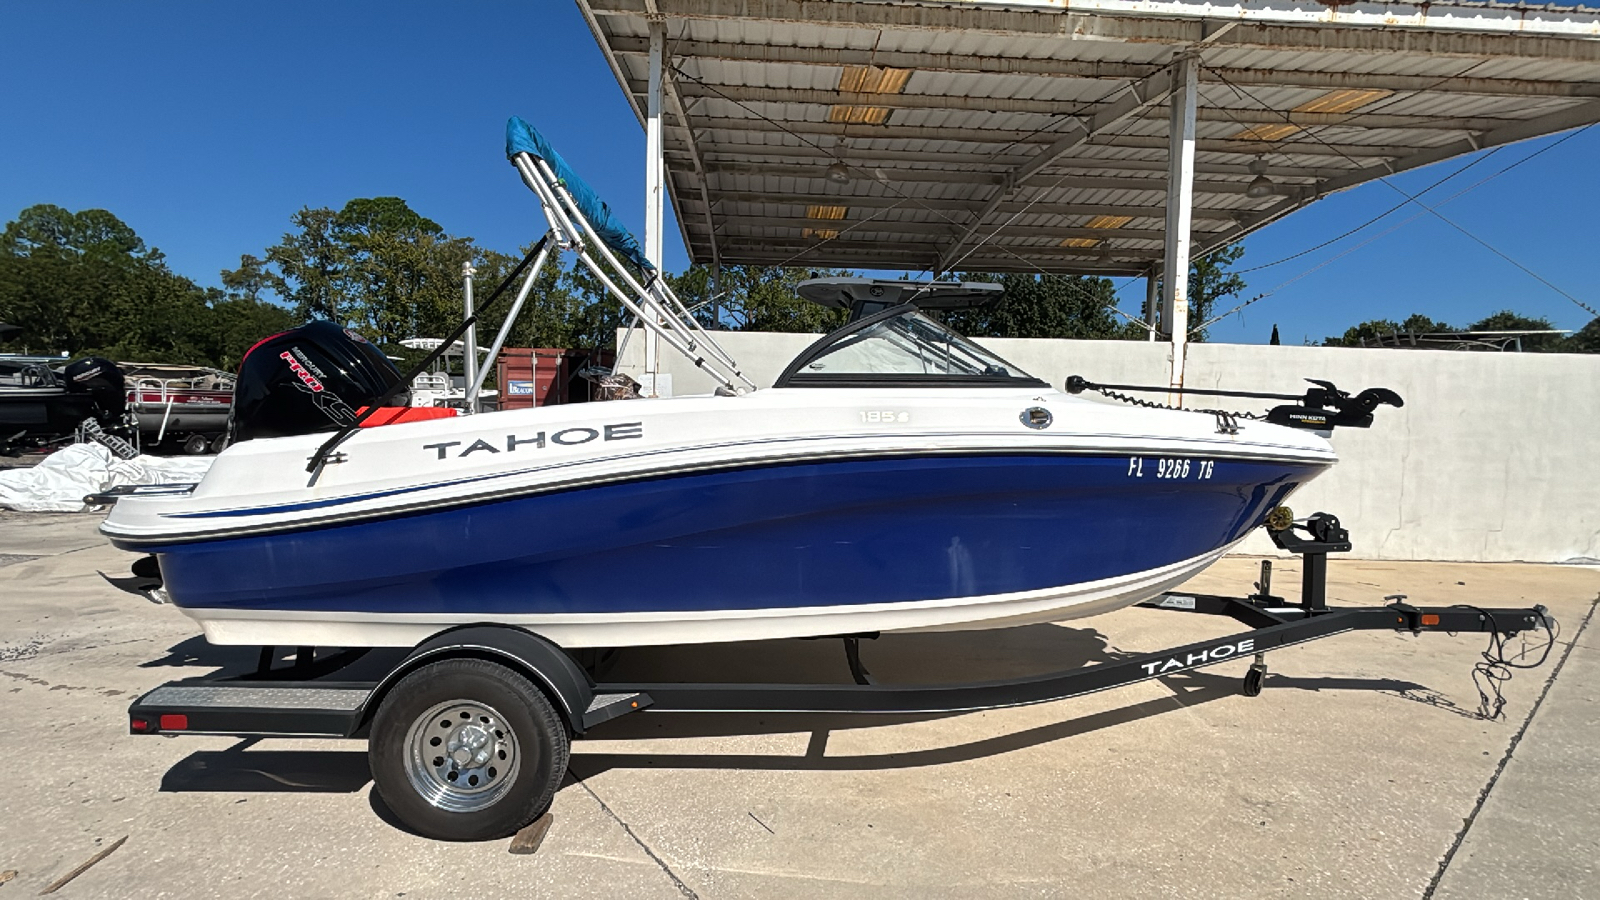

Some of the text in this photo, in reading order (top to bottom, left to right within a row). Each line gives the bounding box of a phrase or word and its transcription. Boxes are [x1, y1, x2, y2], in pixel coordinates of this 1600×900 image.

[280, 351, 324, 392] PRO
[292, 346, 327, 378] MERCURY
[423, 421, 642, 460] TAHOE
[1128, 457, 1214, 480] FL 9266 TG
[1141, 639, 1254, 675] TAHOE
